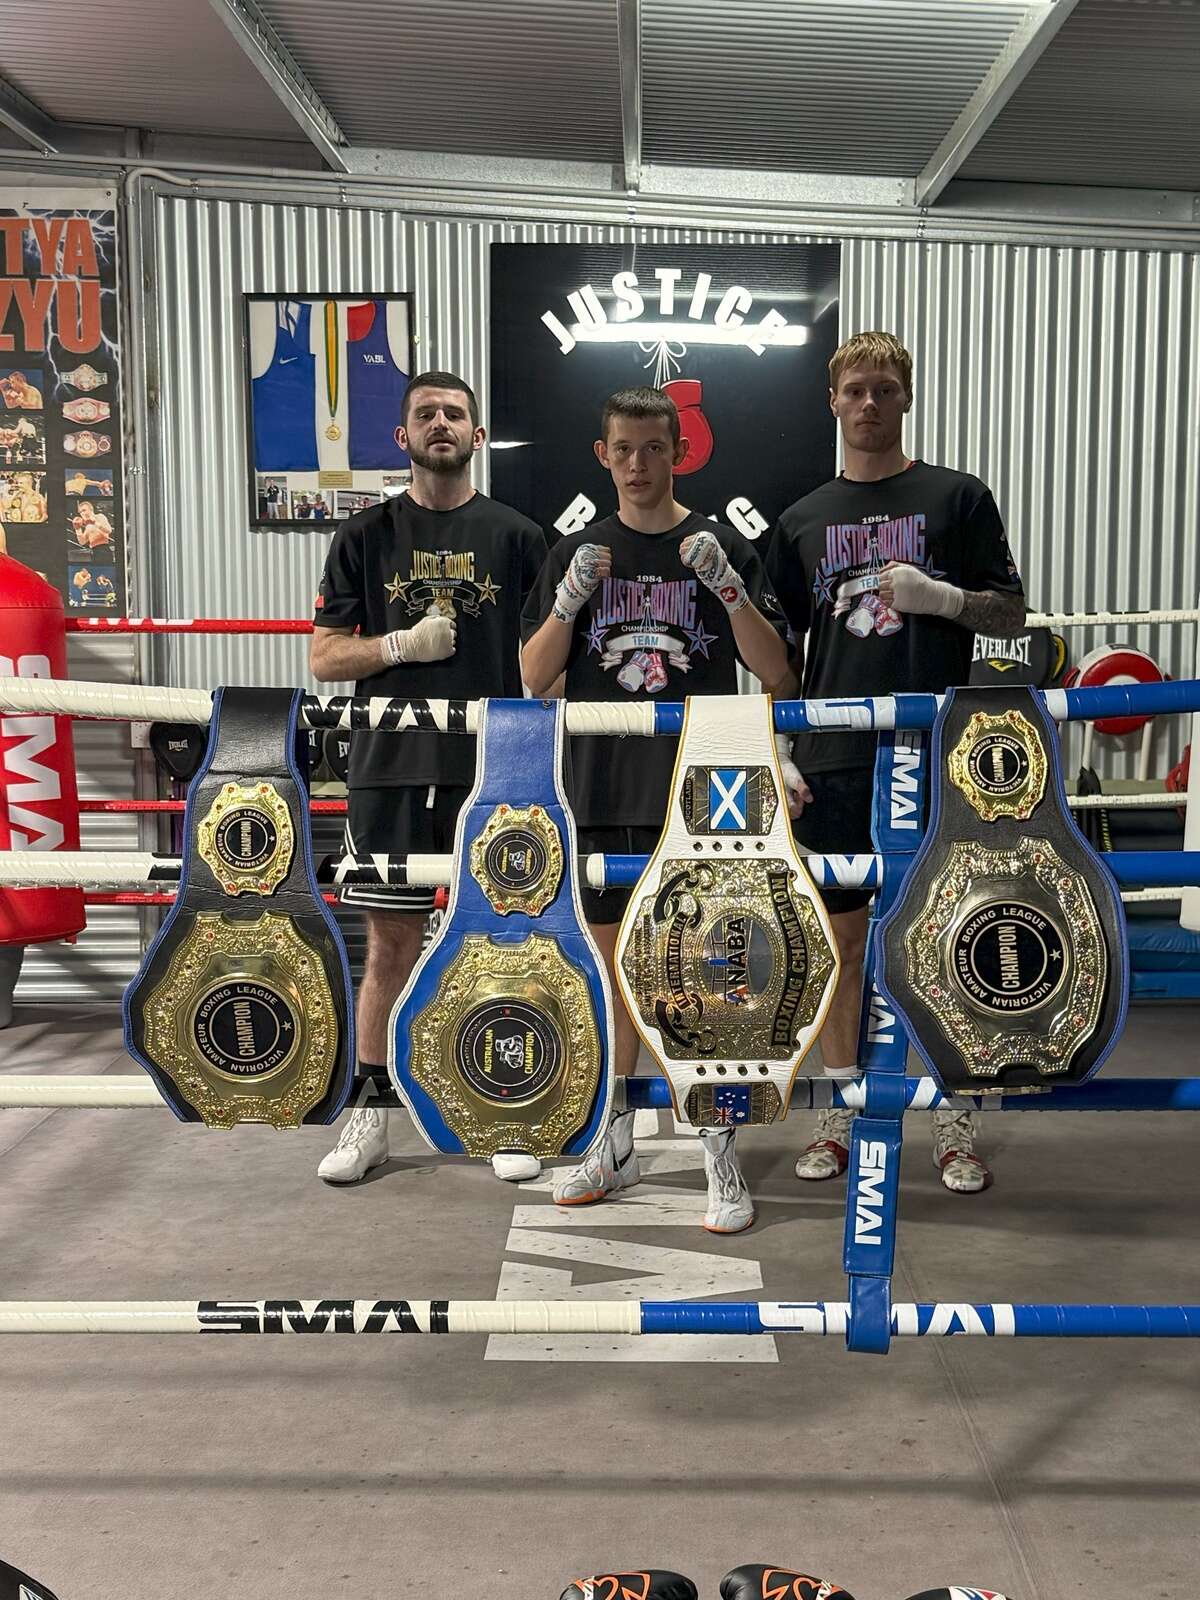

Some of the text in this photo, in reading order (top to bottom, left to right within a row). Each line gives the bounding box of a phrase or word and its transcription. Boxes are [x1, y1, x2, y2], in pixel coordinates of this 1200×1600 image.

[861, 515, 890, 524] 1984
[410, 550, 442, 581] JUSTICE
[820, 513, 926, 577] JUSTICE BOXING
[636, 575, 663, 583] 1984
[861, 577, 880, 588] TEA
[597, 577, 697, 630] JUSTICE BOXING
[621, 625, 669, 633] CHAMPIONSHIP
[632, 635, 659, 646] TEAM
[971, 633, 1032, 666] EVERLAST
[668, 914, 688, 1008] INTERNATIONAL
[727, 917, 746, 985] NABA
[772, 878, 806, 1042] BOXING CHAMPION
[958, 907, 1052, 1007] VICTORIAN AMATEUR BOXING LEAGUE
[998, 925, 1020, 989] CHAMPION
[198, 986, 285, 1073] VICTORIAN AMATEUR BOXING LEAGUE
[233, 1001, 256, 1056] CHAMPION
[484, 1029, 494, 1073] AUSTRALIAN
[524, 1031, 535, 1075] CHAMPION
[854, 1140, 887, 1245] SMAI
[196, 1300, 449, 1334] SMAI
